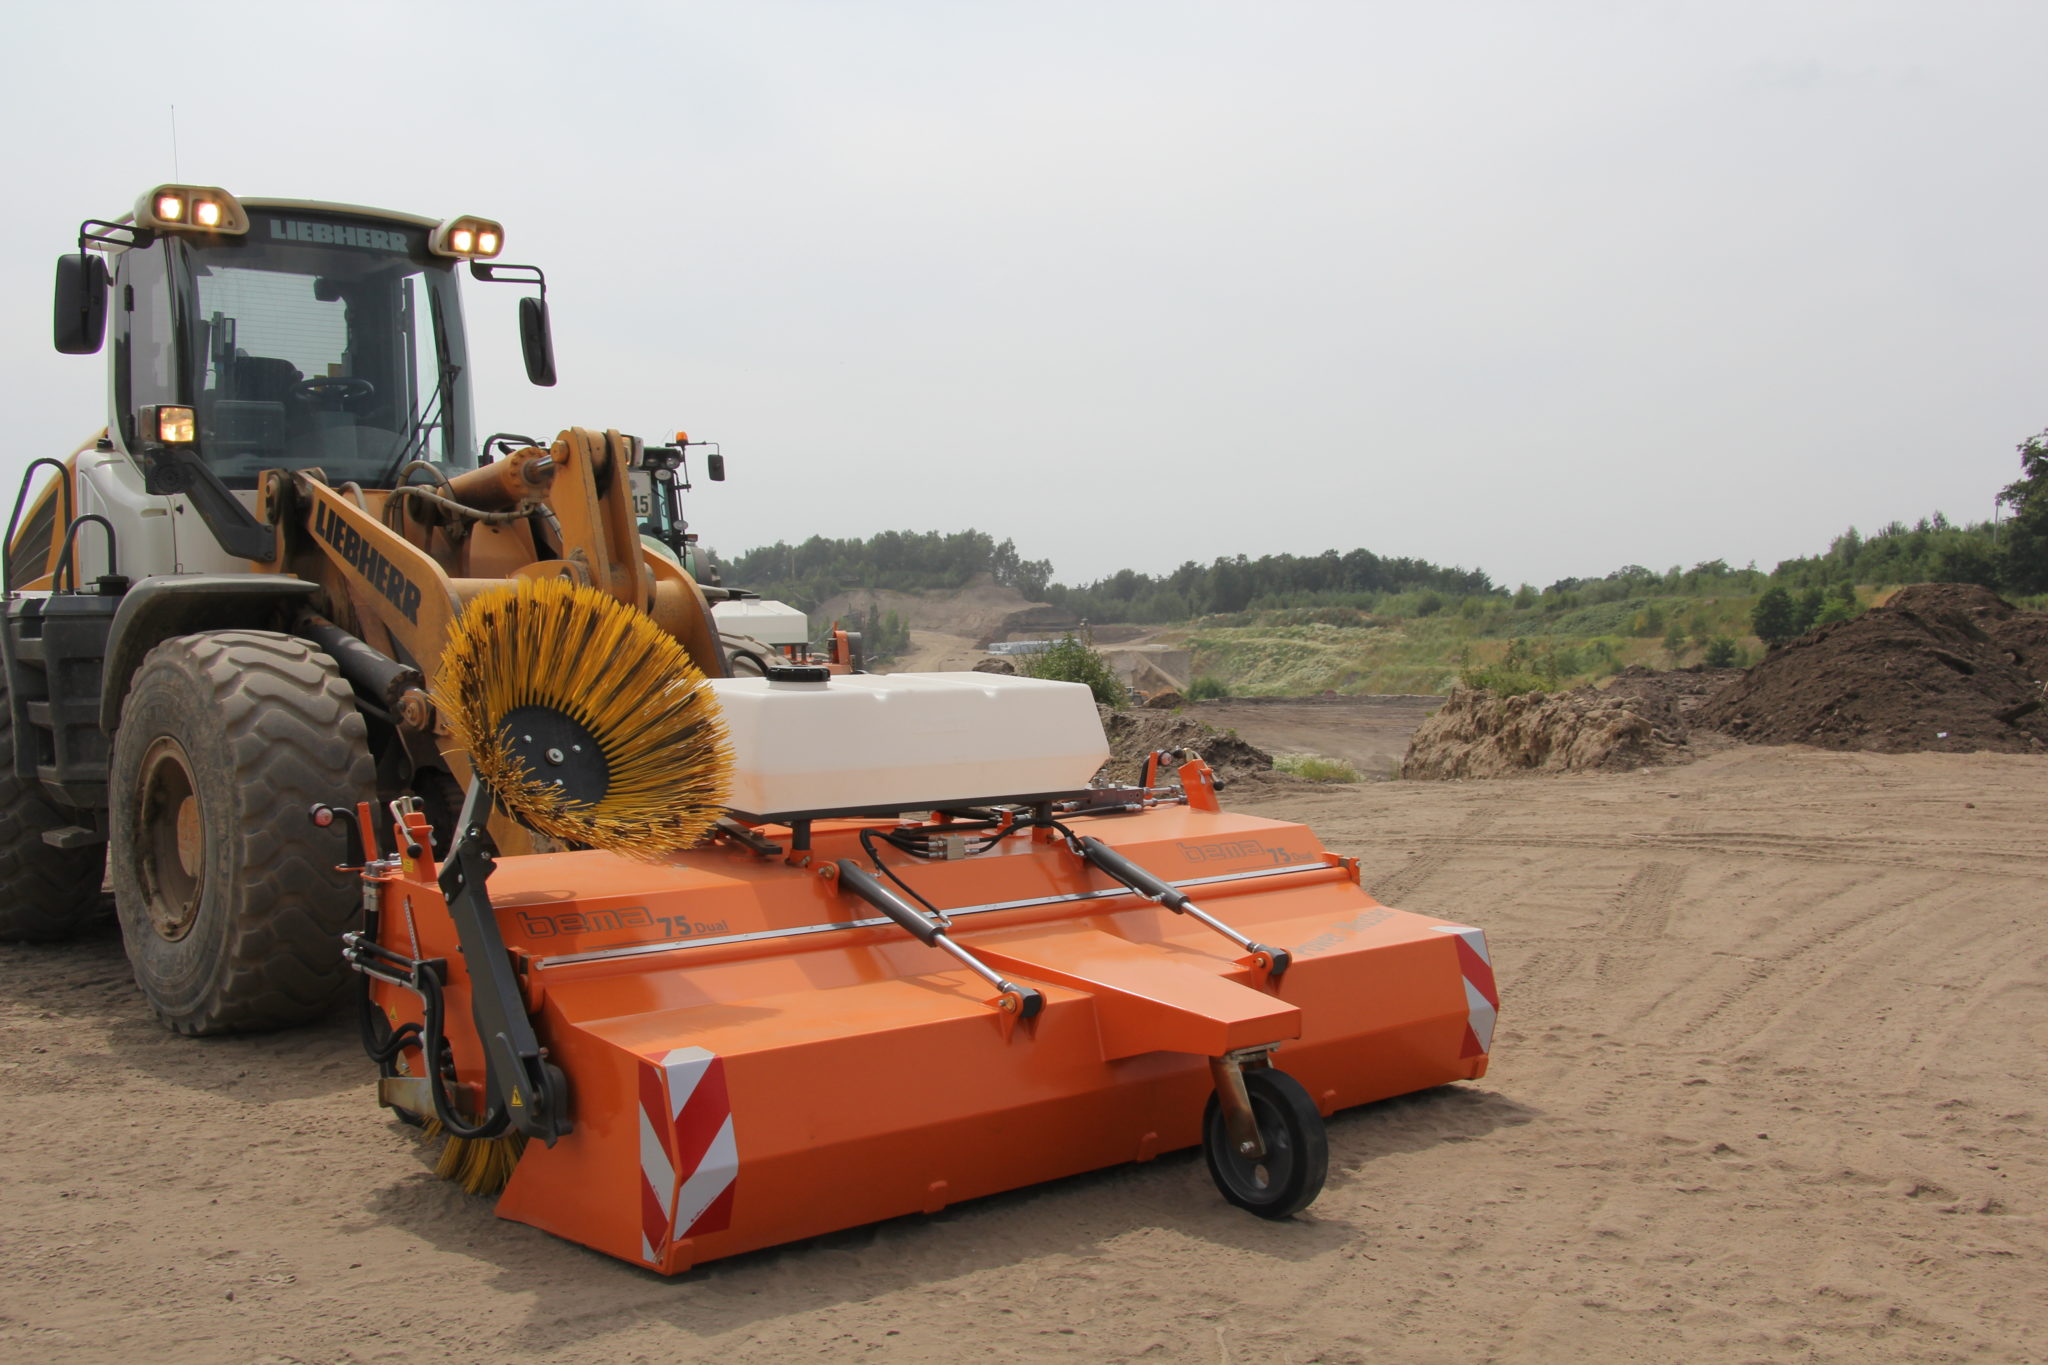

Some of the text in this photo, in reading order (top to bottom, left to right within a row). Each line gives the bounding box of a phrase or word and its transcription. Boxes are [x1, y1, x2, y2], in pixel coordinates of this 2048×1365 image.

[270, 219, 409, 253] LIEBHERR
[315, 499, 422, 627] LIEBHERR
[1176, 839, 1267, 863] bema
[1266, 847, 1291, 864] 75
[517, 906, 729, 939] bema 75 Dual
